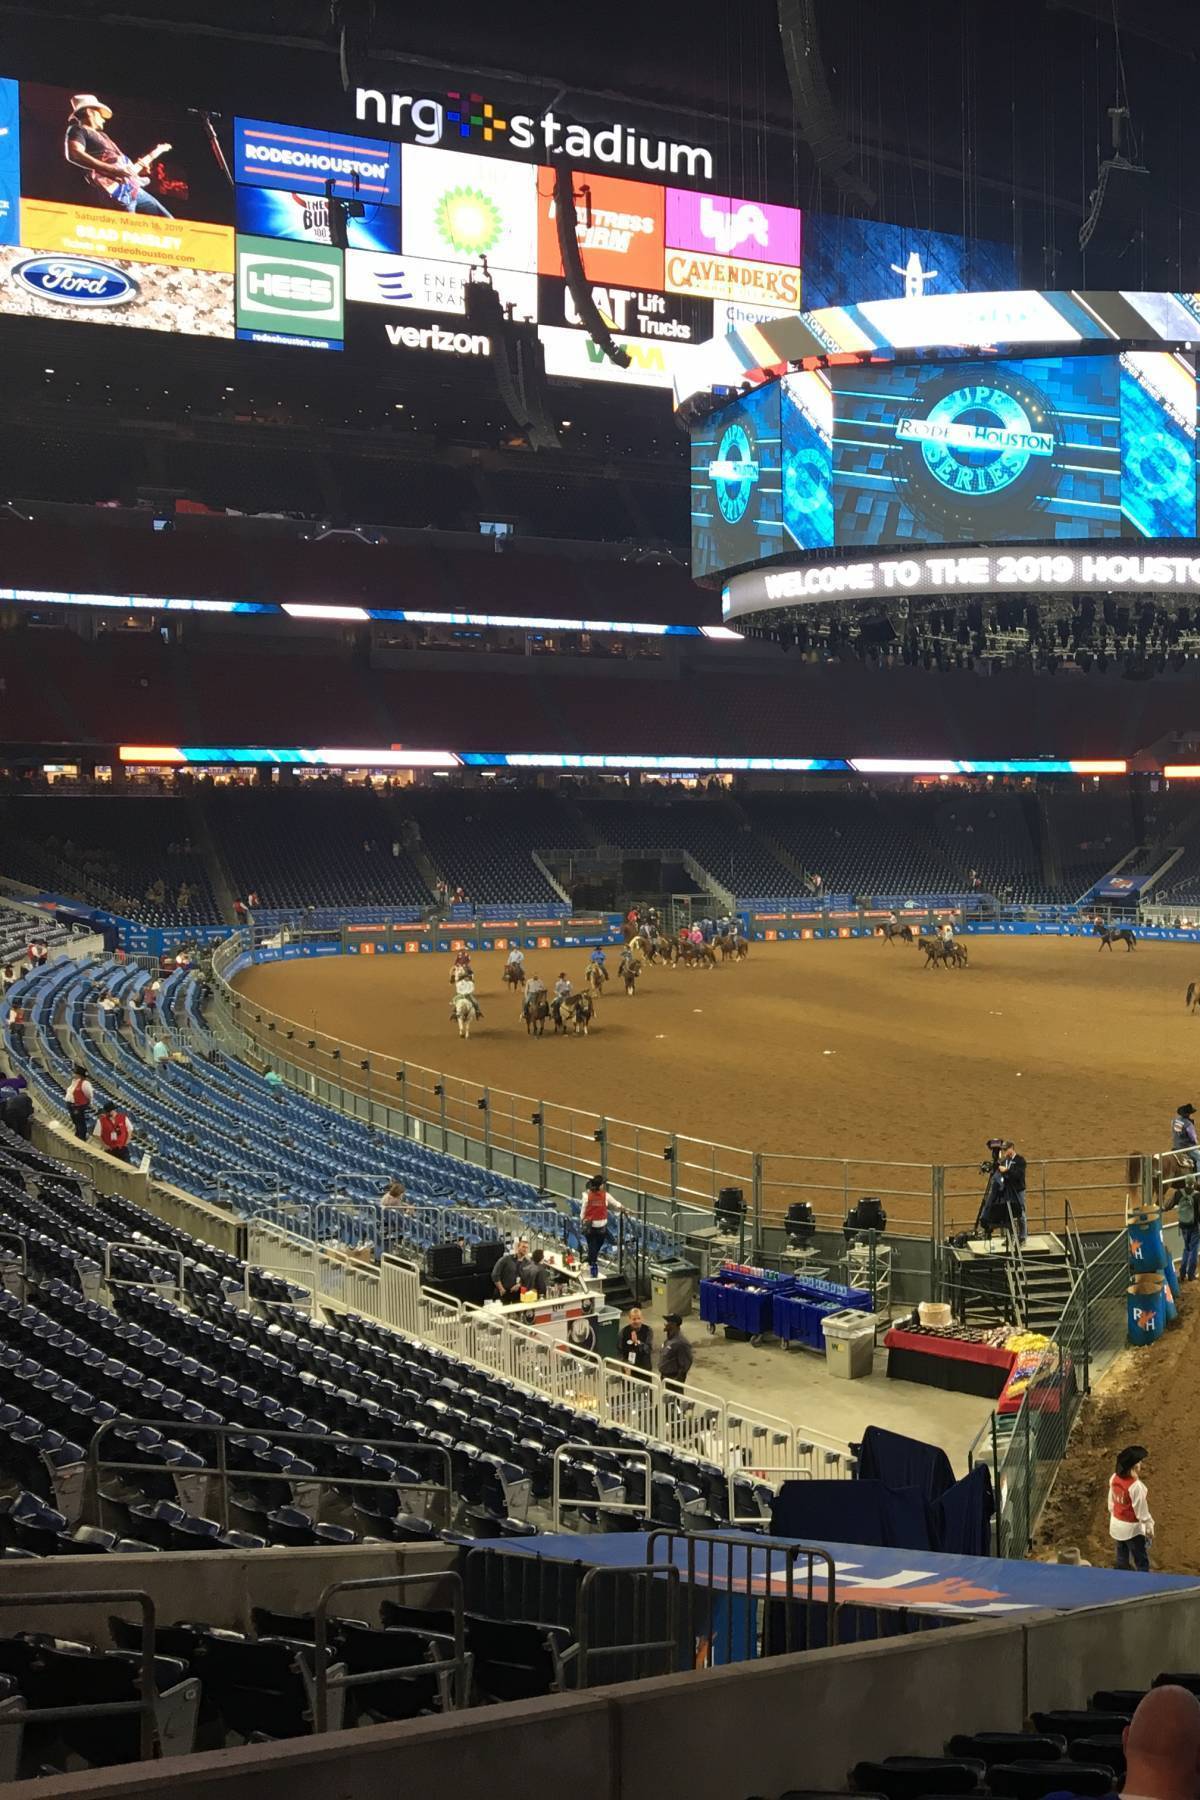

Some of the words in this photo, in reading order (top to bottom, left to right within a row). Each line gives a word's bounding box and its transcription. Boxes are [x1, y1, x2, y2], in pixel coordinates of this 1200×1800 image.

[355, 86, 443, 144] nrg
[508, 111, 713, 179] stadium
[245, 143, 388, 179] RODEOHOUSTON
[303, 210, 330, 230] BUL
[305, 200, 325, 211] THE
[75, 211, 117, 225] Saturday,
[120, 217, 149, 229] March
[164, 223, 184, 233] 2019
[107, 246, 195, 263] rodeohouston.com
[42, 263, 107, 295] Ford
[248, 271, 332, 303] HESS
[423, 273, 466, 289] ENER
[668, 256, 798, 304] CAVENDER'S
[637, 292, 666, 314] Lift
[385, 324, 490, 356] verizon
[637, 314, 691, 339] Trucks
[925, 447, 1022, 491] SERIES
[764, 563, 874, 600] WELCOME
[878, 560, 920, 587] TO
[925, 557, 989, 585] THE
[996, 555, 1074, 583] 2019
